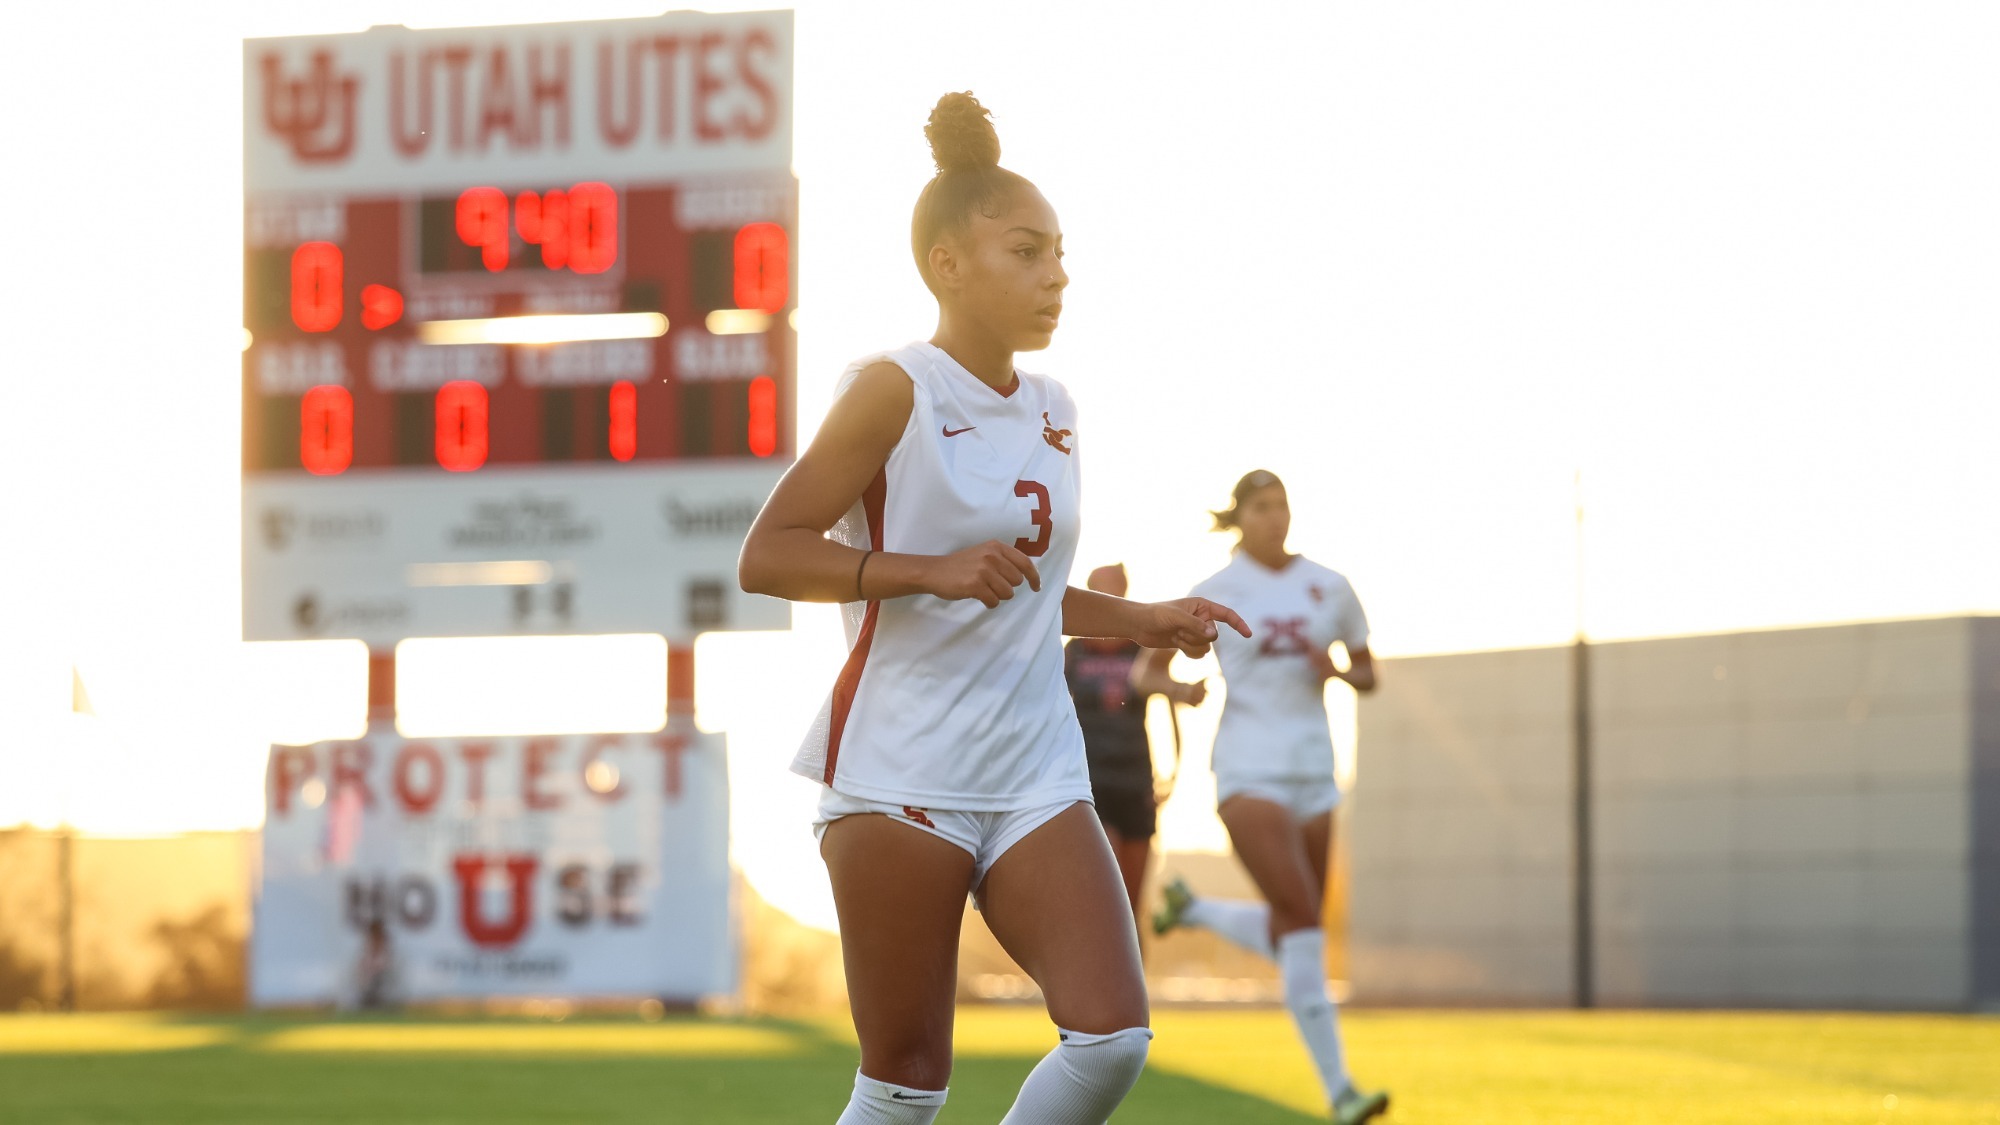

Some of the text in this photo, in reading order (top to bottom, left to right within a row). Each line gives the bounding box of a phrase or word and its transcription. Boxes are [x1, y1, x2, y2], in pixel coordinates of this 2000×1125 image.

[388, 42, 572, 158] UTAH
[597, 29, 780, 147] UTES
[291, 241, 343, 332] 0
[734, 222, 789, 315] 0
[301, 385, 353, 475] 0
[435, 380, 489, 472] 0
[609, 380, 636, 462] 1
[748, 376, 776, 457] 1
[1014, 479, 1053, 557] 3
[1259, 615, 1310, 656] 25
[271, 733, 692, 815] PROTECT
